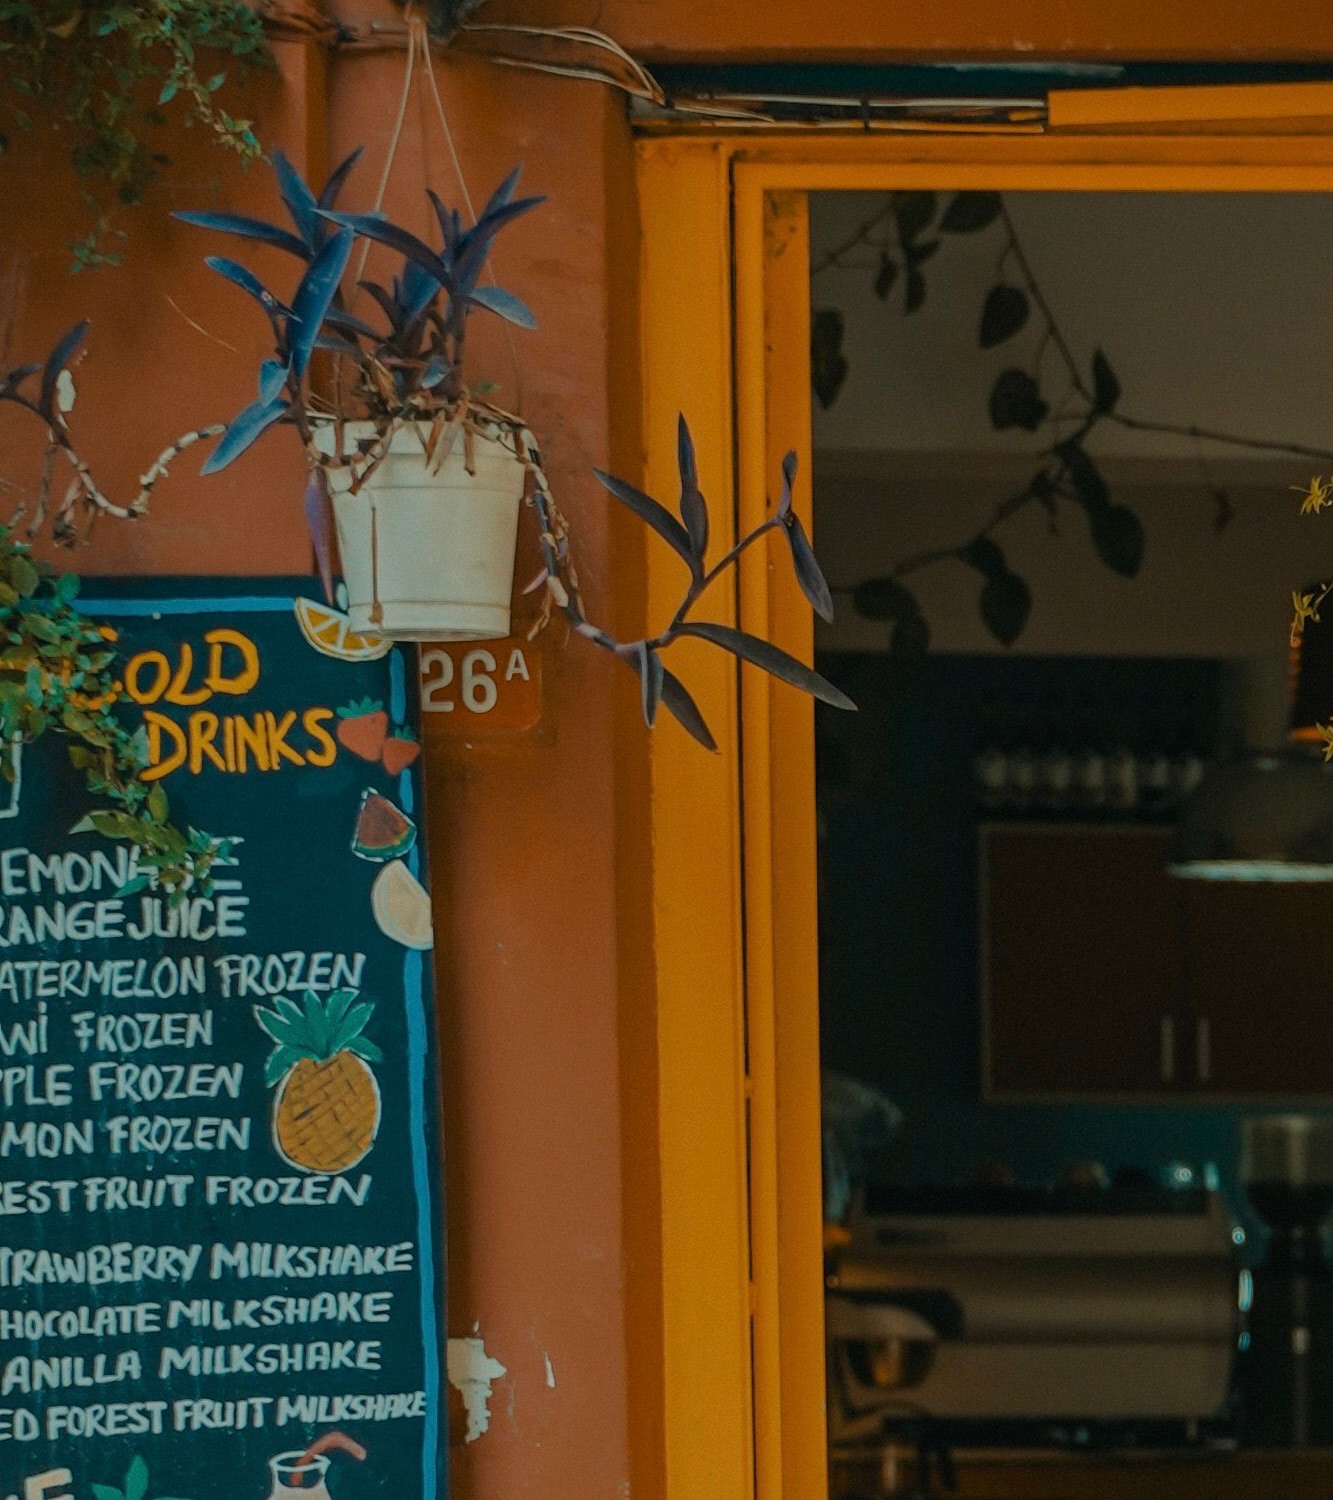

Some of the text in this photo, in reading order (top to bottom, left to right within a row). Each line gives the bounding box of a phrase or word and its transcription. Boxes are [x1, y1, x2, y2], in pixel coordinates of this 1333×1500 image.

[139, 707, 339, 782] DRINKS
[125, 895, 251, 942] JUICE
[213, 950, 366, 997] FROZEN
[70, 1009, 214, 1053] FROZEN
[88, 1061, 244, 1103] FROZEN
[105, 1115, 251, 1155] FROZEN
[81, 1174, 195, 1213] FRUIT
[205, 1173, 373, 1207] FROZEN
[209, 1241, 415, 1281] MILKSHAKE
[166, 1291, 394, 1331] MILKSHAKE
[0, 1340, 383, 1397] ANILLA MILKSHAKE
[45, 1400, 168, 1441] FOREST
[173, 1397, 274, 1434] FRUIT
[275, 1391, 428, 1427] MILKSHAKE
